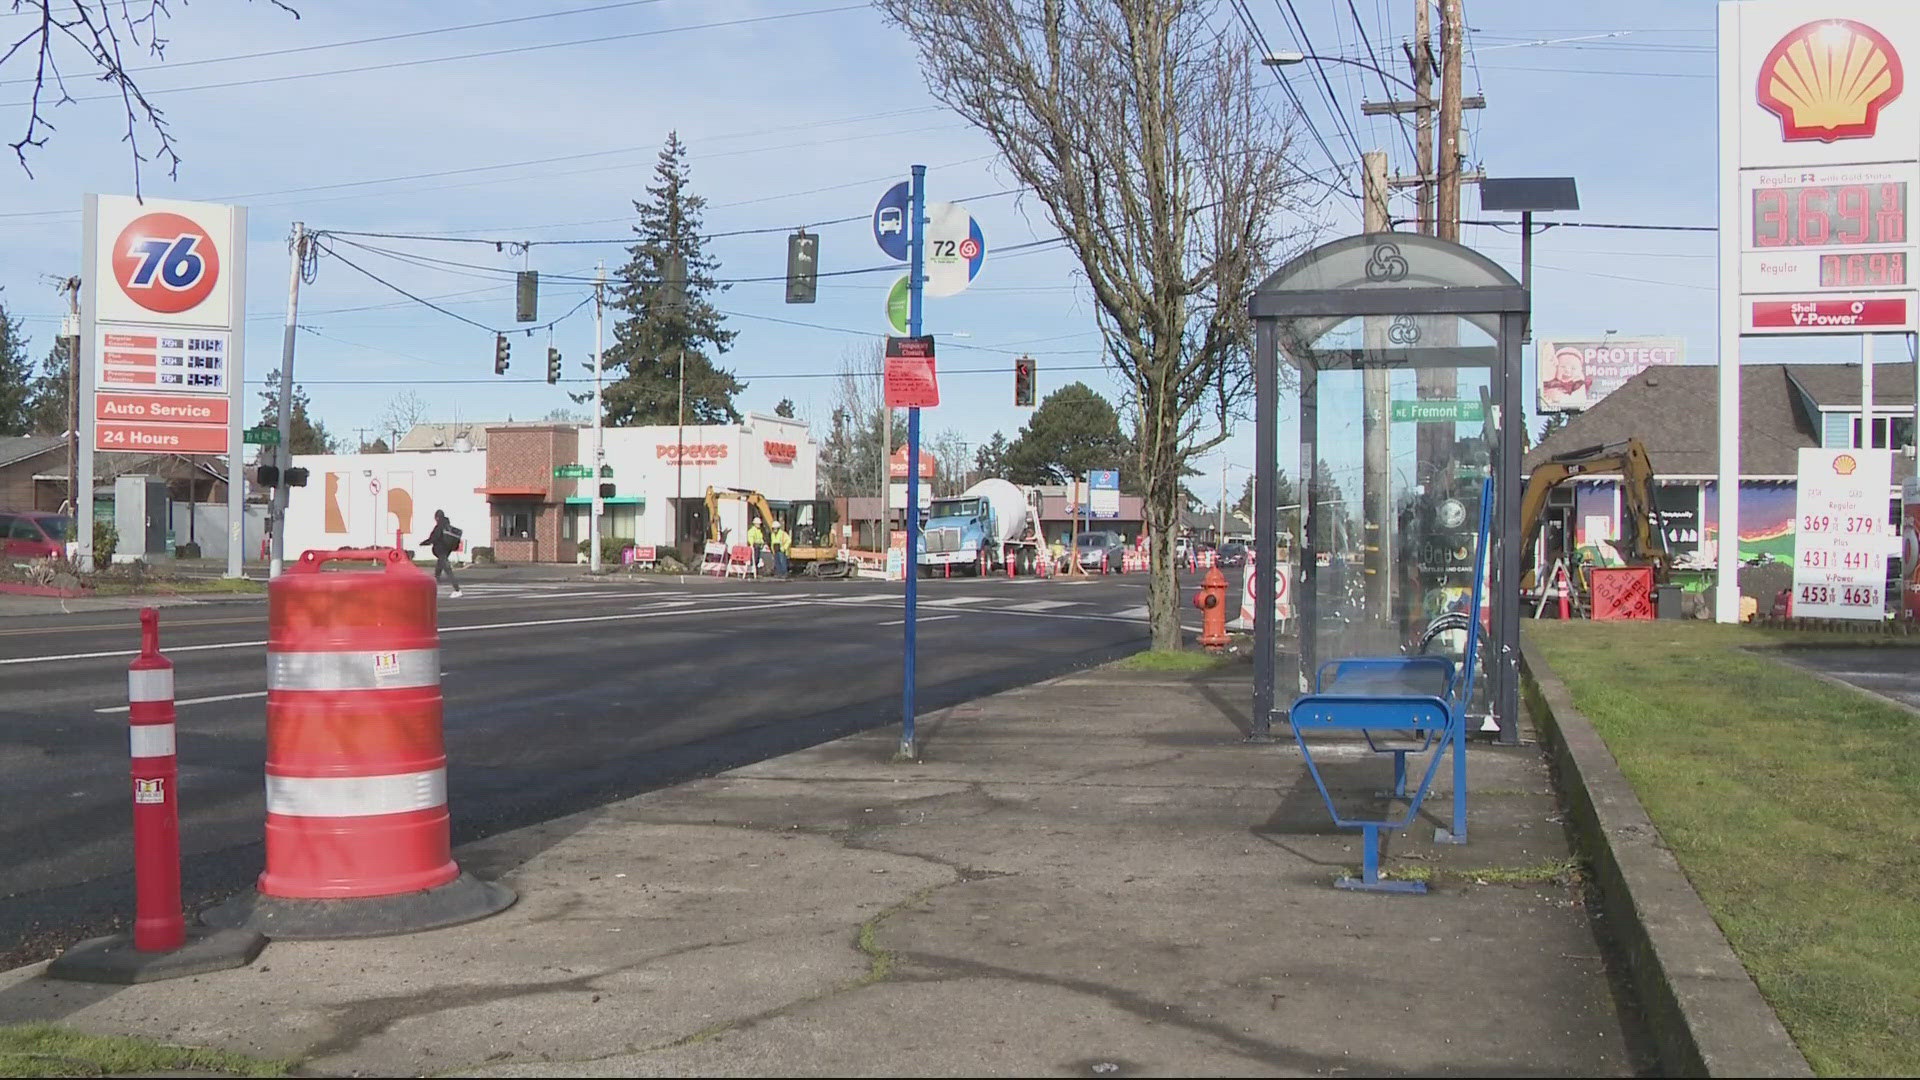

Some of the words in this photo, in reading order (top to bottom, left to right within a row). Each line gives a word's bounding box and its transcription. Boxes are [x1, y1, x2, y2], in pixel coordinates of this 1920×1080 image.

[1760, 174, 1797, 187] Regular
[1841, 173, 1862, 181] Gold
[1865, 173, 1892, 181] Status
[933, 240, 956, 257] 72
[129, 235, 203, 289] 76
[1760, 262, 1797, 275] Regular
[1791, 303, 1817, 313] Shell
[1791, 313, 1859, 326] V-Power
[1584, 348, 1676, 364] PROTECT
[1585, 365, 1618, 377] Mom
[1620, 365, 1637, 377] and
[103, 401, 145, 415] Auto
[150, 403, 211, 417] Service
[1396, 408, 1407, 417] NE
[1411, 405, 1458, 417] Fremont
[103, 431, 125, 443] 24
[130, 432, 179, 445] Hours
[1829, 501, 1856, 511] Regular
[1804, 515, 1830, 532] 369
[1846, 517, 1873, 533] 379
[1803, 551, 1828, 567] 431
[1844, 552, 1869, 568] 441
[1621, 571, 1648, 600] STEEL
[1825, 573, 1854, 583] V-Power
[1596, 583, 1637, 619] ROADWA
[1605, 574, 1634, 602] PLATE
[1633, 600, 1650, 616] ON
[1802, 586, 1828, 602] 453
[1844, 588, 1870, 604] 463
